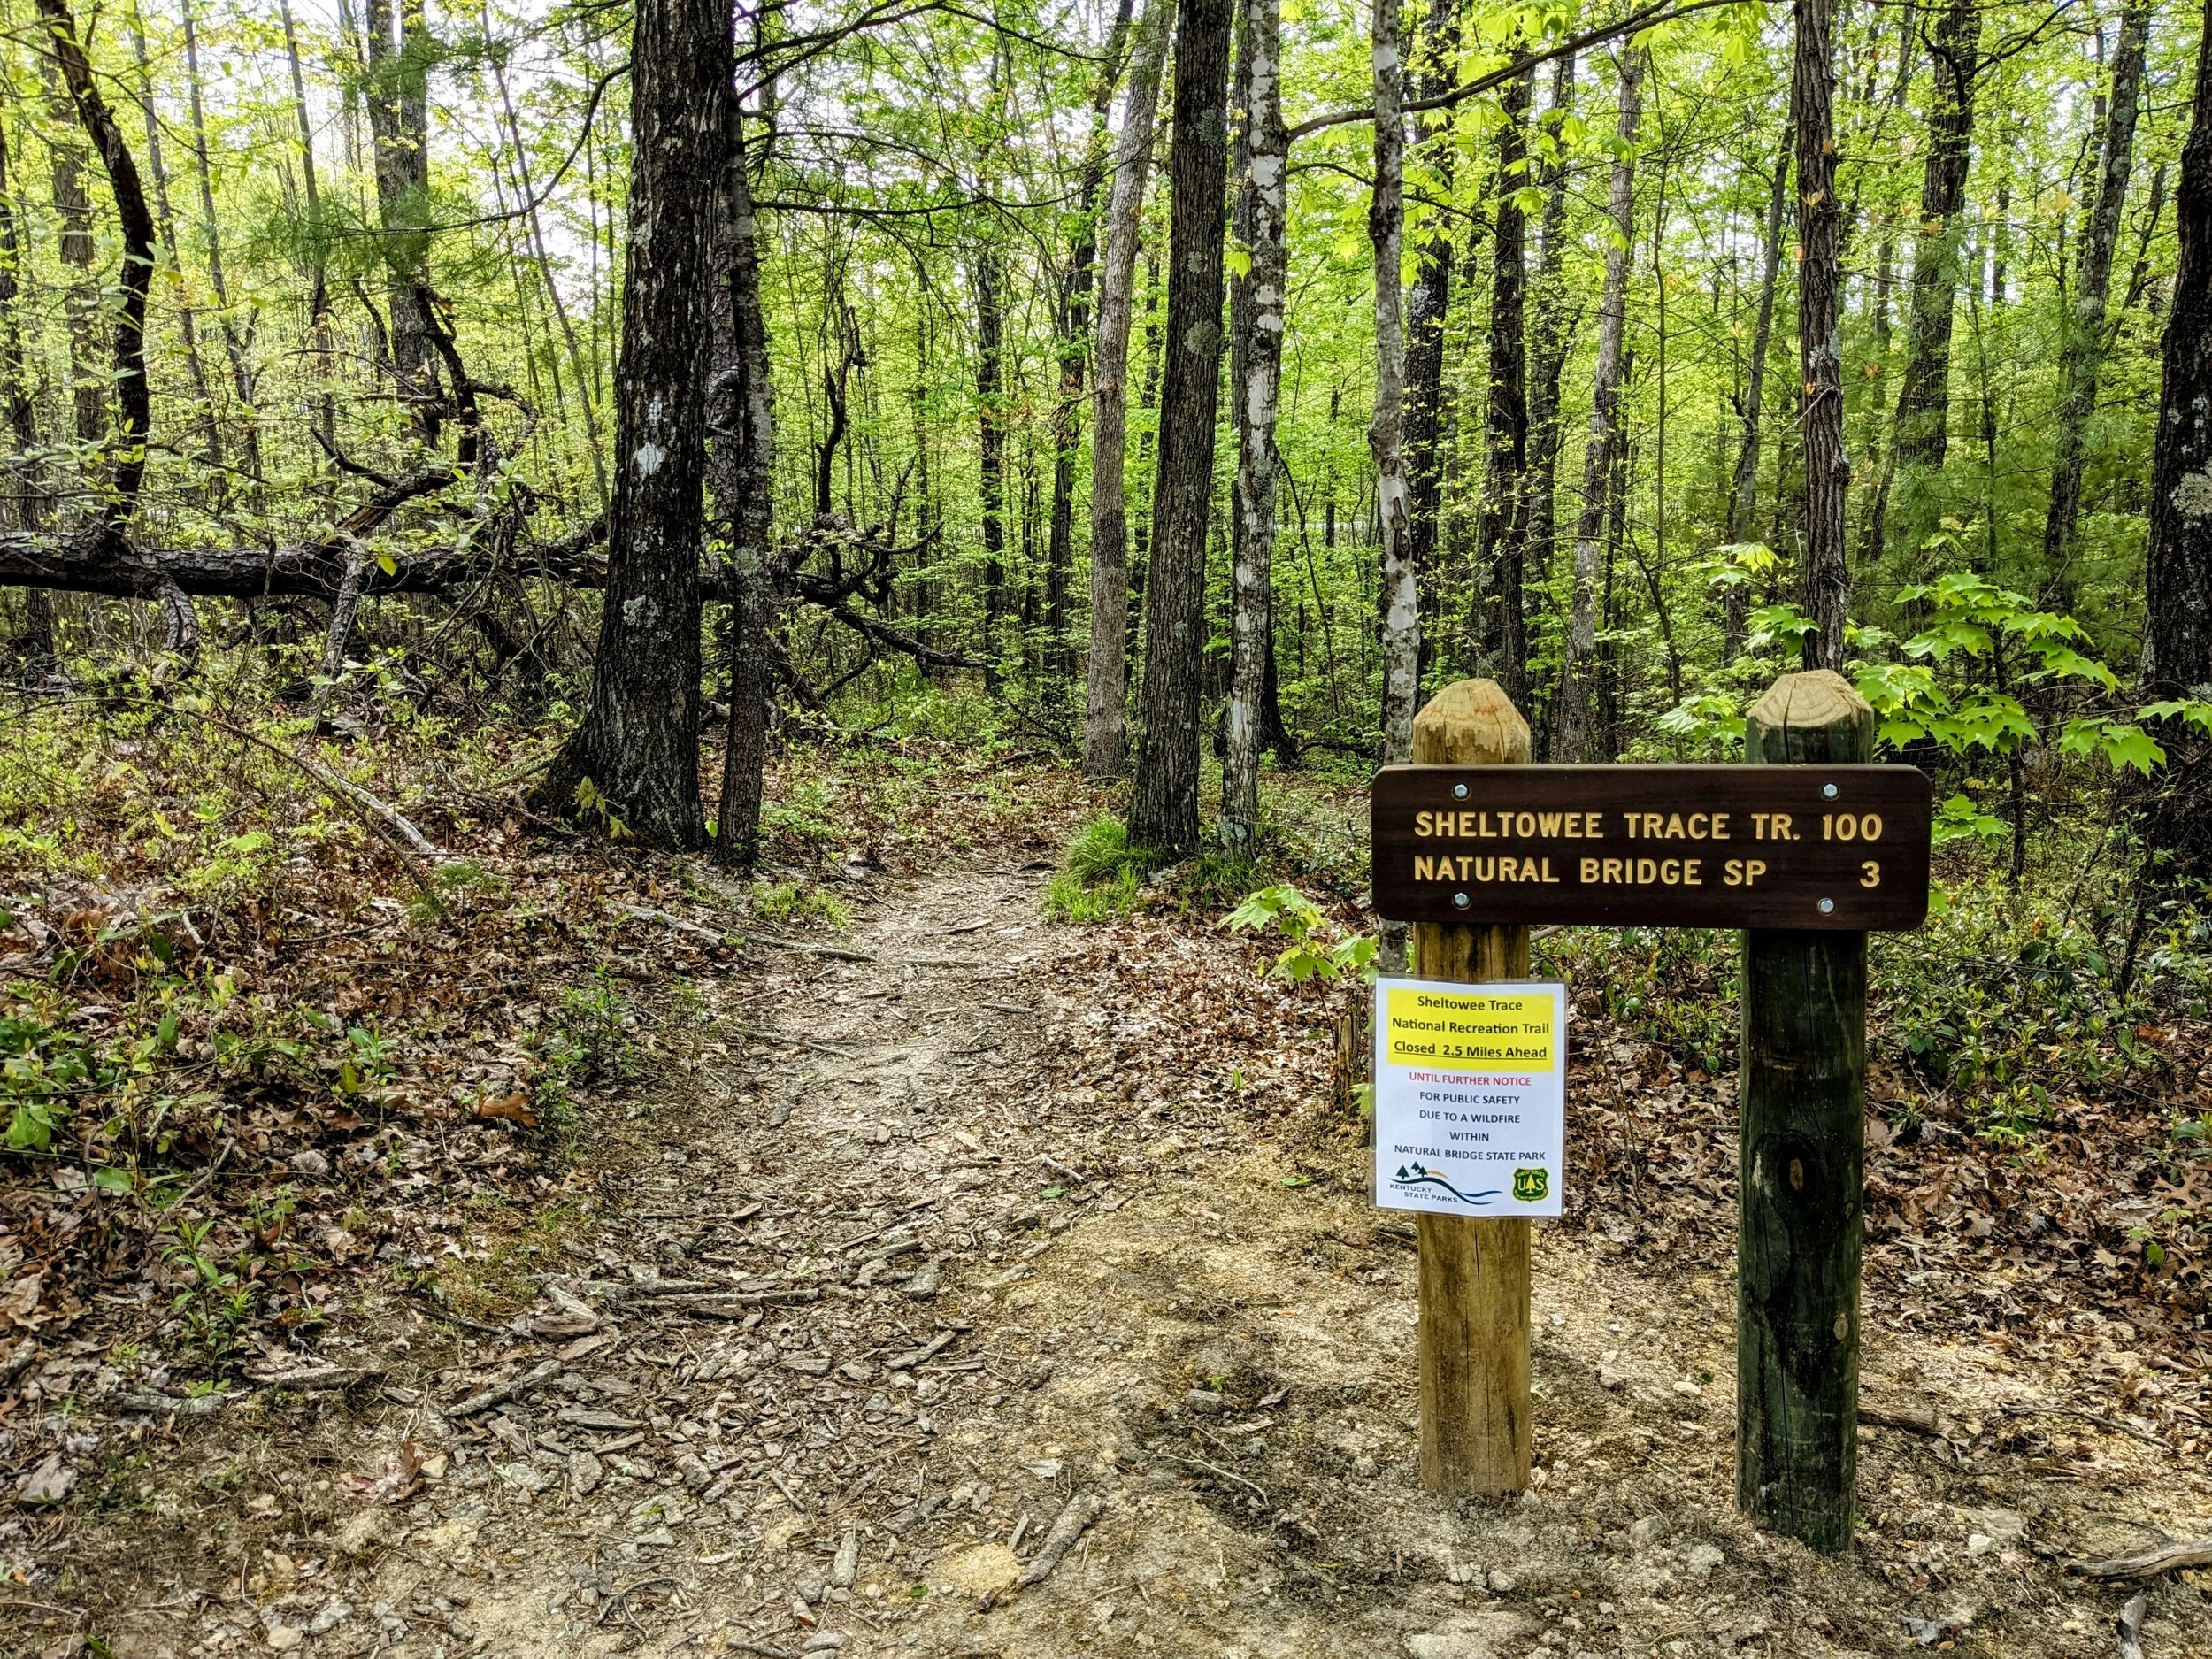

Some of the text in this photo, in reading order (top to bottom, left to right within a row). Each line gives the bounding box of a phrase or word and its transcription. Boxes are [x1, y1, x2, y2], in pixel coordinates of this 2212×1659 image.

[1415, 811, 1883, 842] SHELTOWEE TRACE TR. 100
[1415, 856, 1880, 887] NATURAL BRIDGE SP 3
[1417, 996, 1522, 1010] Sheltowee Trace
[1393, 1018, 1549, 1033] National Recreation Trail
[1394, 1041, 1547, 1058] Closed 2.5 Miles Ahead
[1409, 1072, 1531, 1086] UNTIL FURTHER NOTICE
[1420, 1092, 1520, 1104] FOR PUBLIC SAFETY
[1419, 1110, 1440, 1120] DUE
[1445, 1112, 1457, 1121] TO
[1449, 1132, 1489, 1141] WITHIN
[1394, 1145, 1441, 1156] NATURAL
[1445, 1149, 1483, 1160] BRIDGE
[1486, 1151, 1516, 1160] STATE
[1390, 1183, 1432, 1193] KENTUCKY
[1432, 1194, 1458, 1203] PARKS
